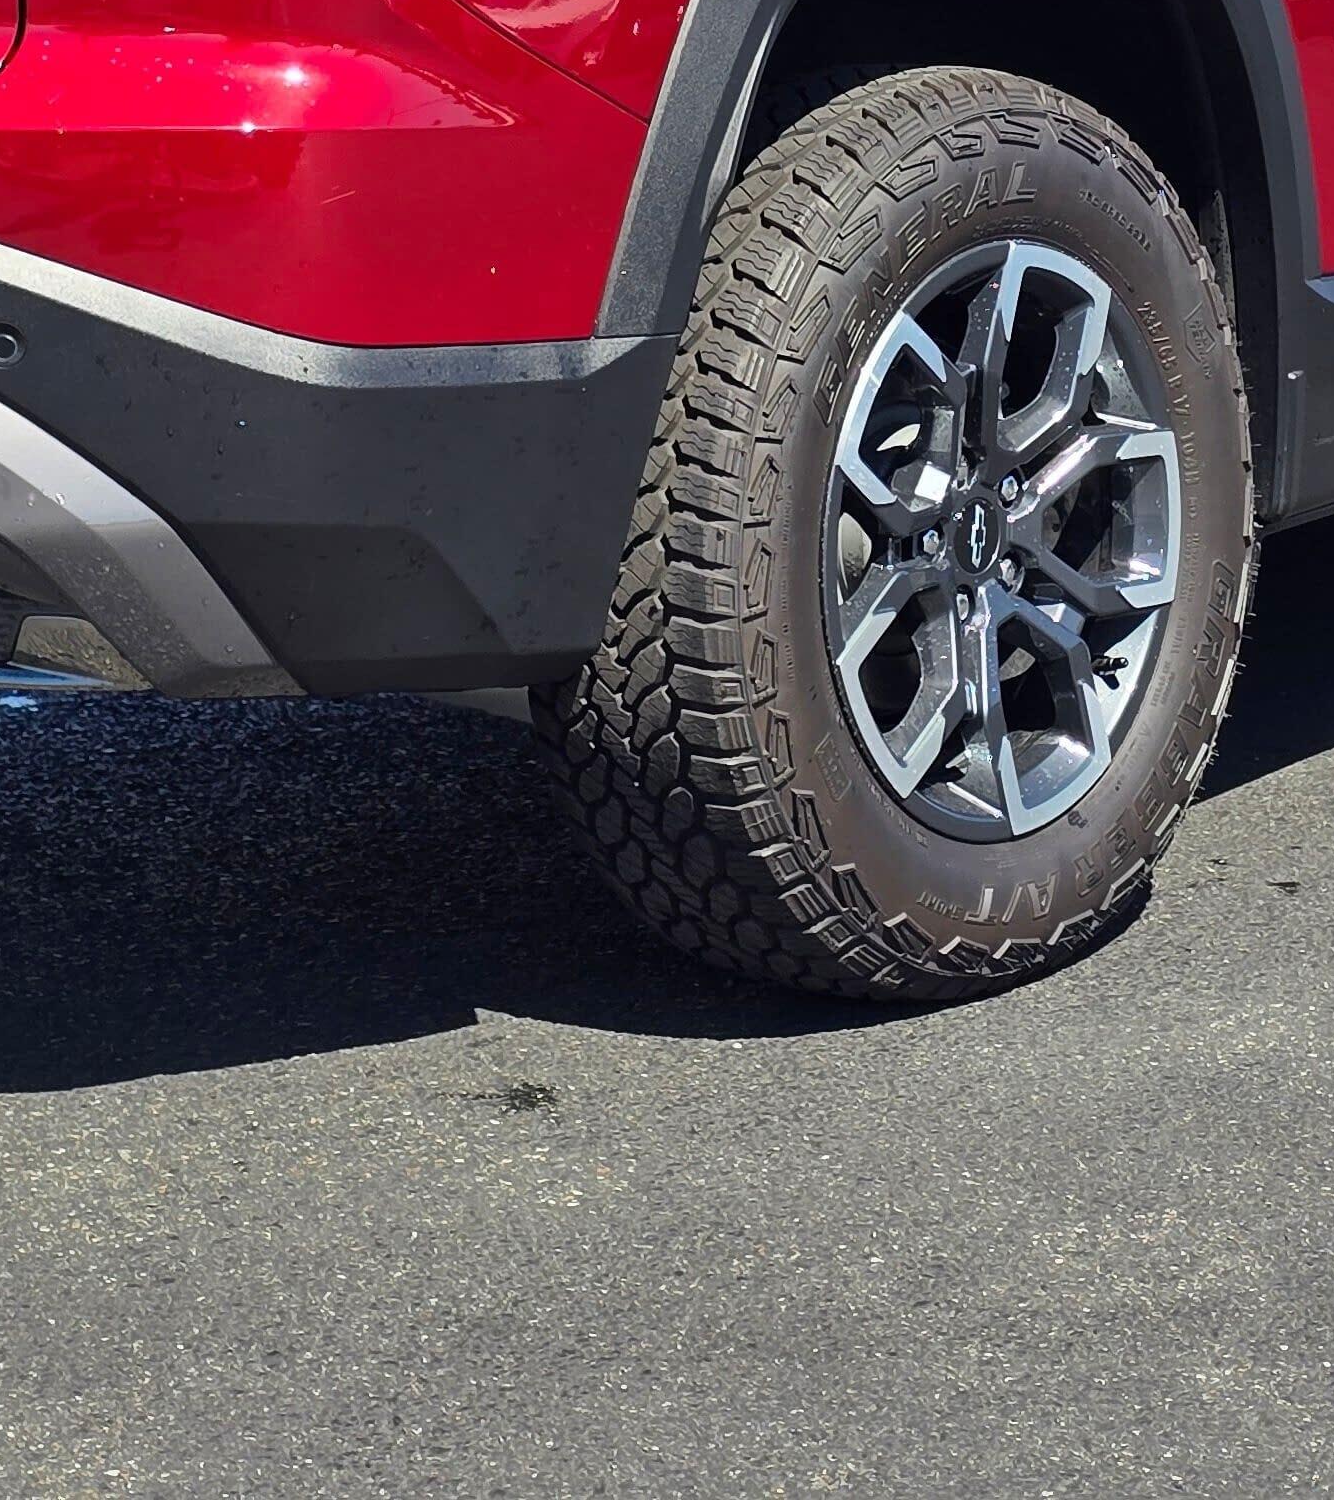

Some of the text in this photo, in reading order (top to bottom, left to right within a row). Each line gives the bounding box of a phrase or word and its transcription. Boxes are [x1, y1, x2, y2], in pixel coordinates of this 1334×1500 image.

[813, 161, 1038, 427] GENERAL
[1073, 559, 1236, 898] GRABBER
[963, 869, 1061, 925] A/T
